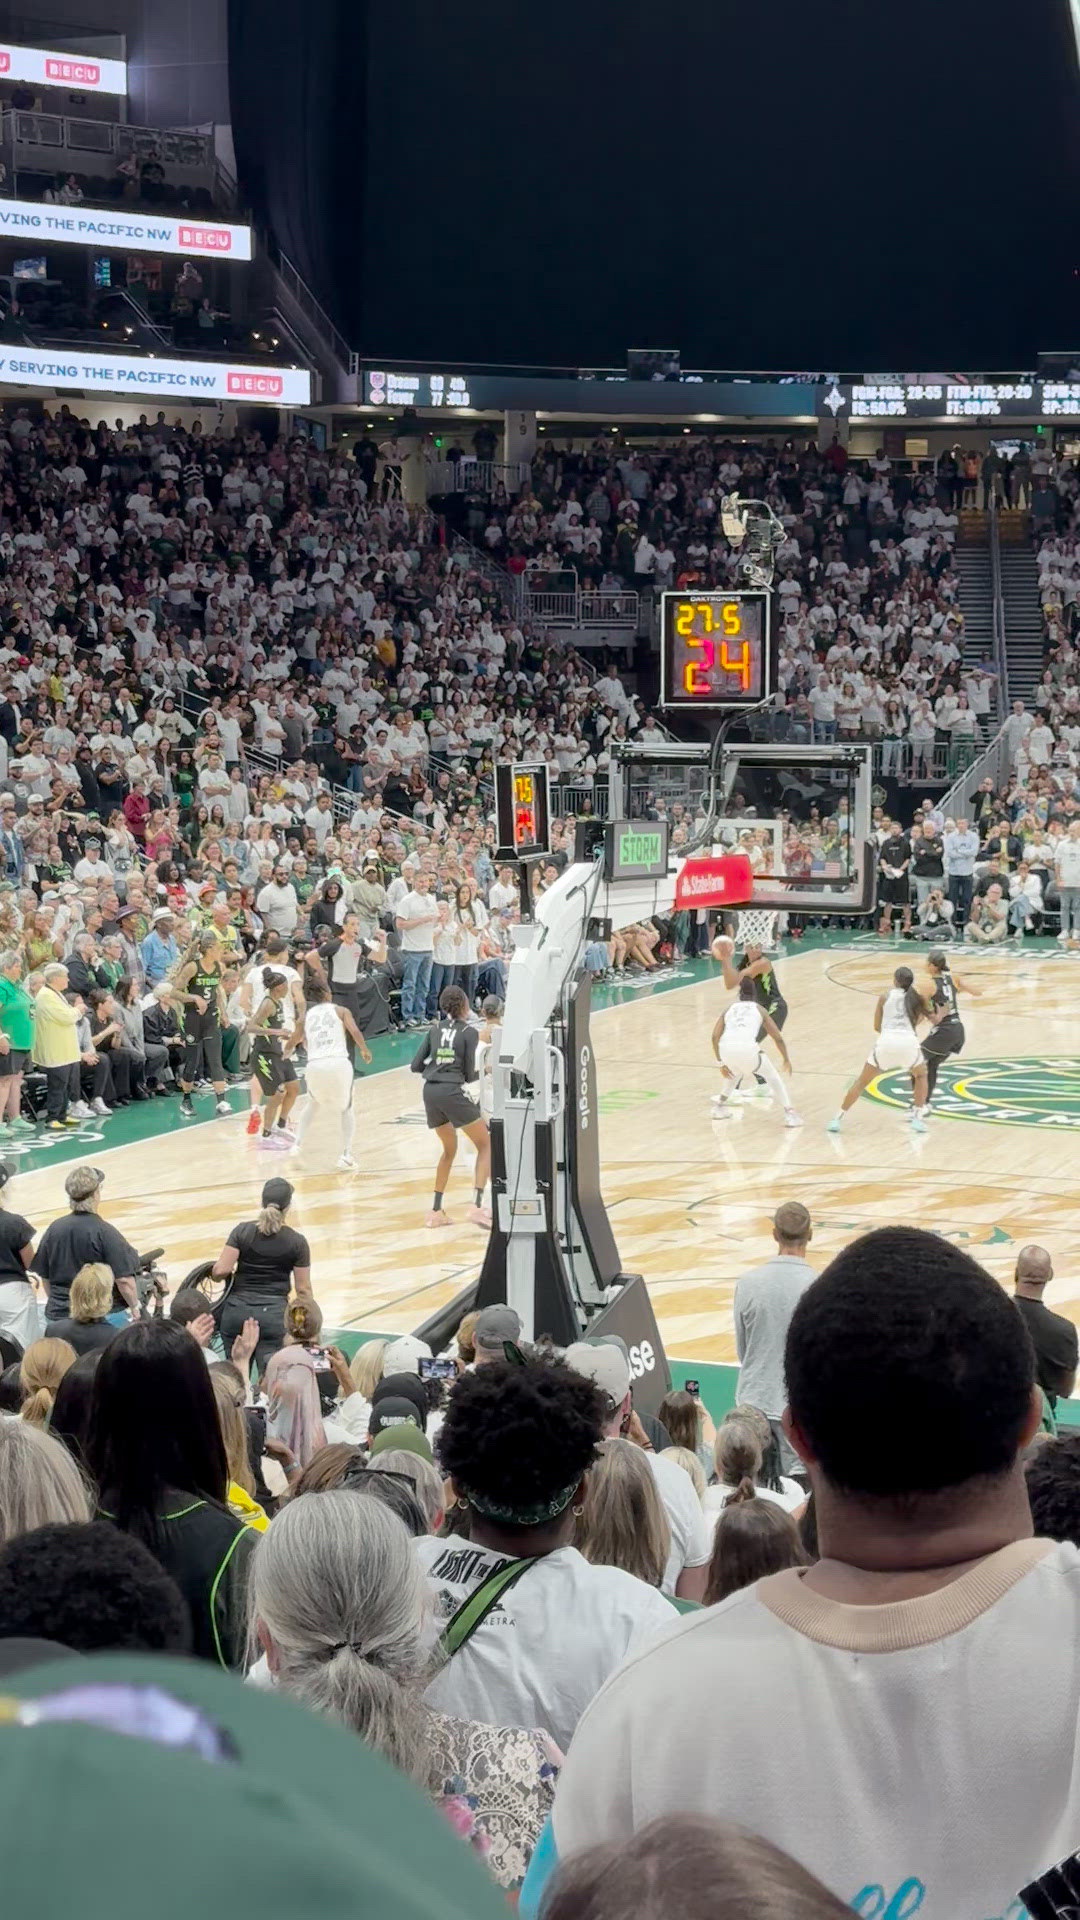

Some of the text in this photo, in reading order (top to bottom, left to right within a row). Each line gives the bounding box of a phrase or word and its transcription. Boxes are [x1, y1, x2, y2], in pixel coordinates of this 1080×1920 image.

[49, 62, 97, 80] BECU
[45, 216, 75, 231] THE
[78, 220, 144, 238] PACIFIC
[147, 228, 172, 241] NW
[182, 230, 229, 247] BECU
[9, 361, 78, 377] SERVING
[82, 366, 114, 380] THE
[117, 369, 187, 386] PACIFIC
[190, 376, 216, 388] NW
[230, 376, 279, 392] BECU
[677, 604, 740, 635] 27.5
[684, 638, 750, 694] 24
[622, 836, 659, 863] STORM
[203, 987, 212, 999] 5
[580, 1045, 590, 1129] Google
[427, 1549, 487, 1584] LIGHT
